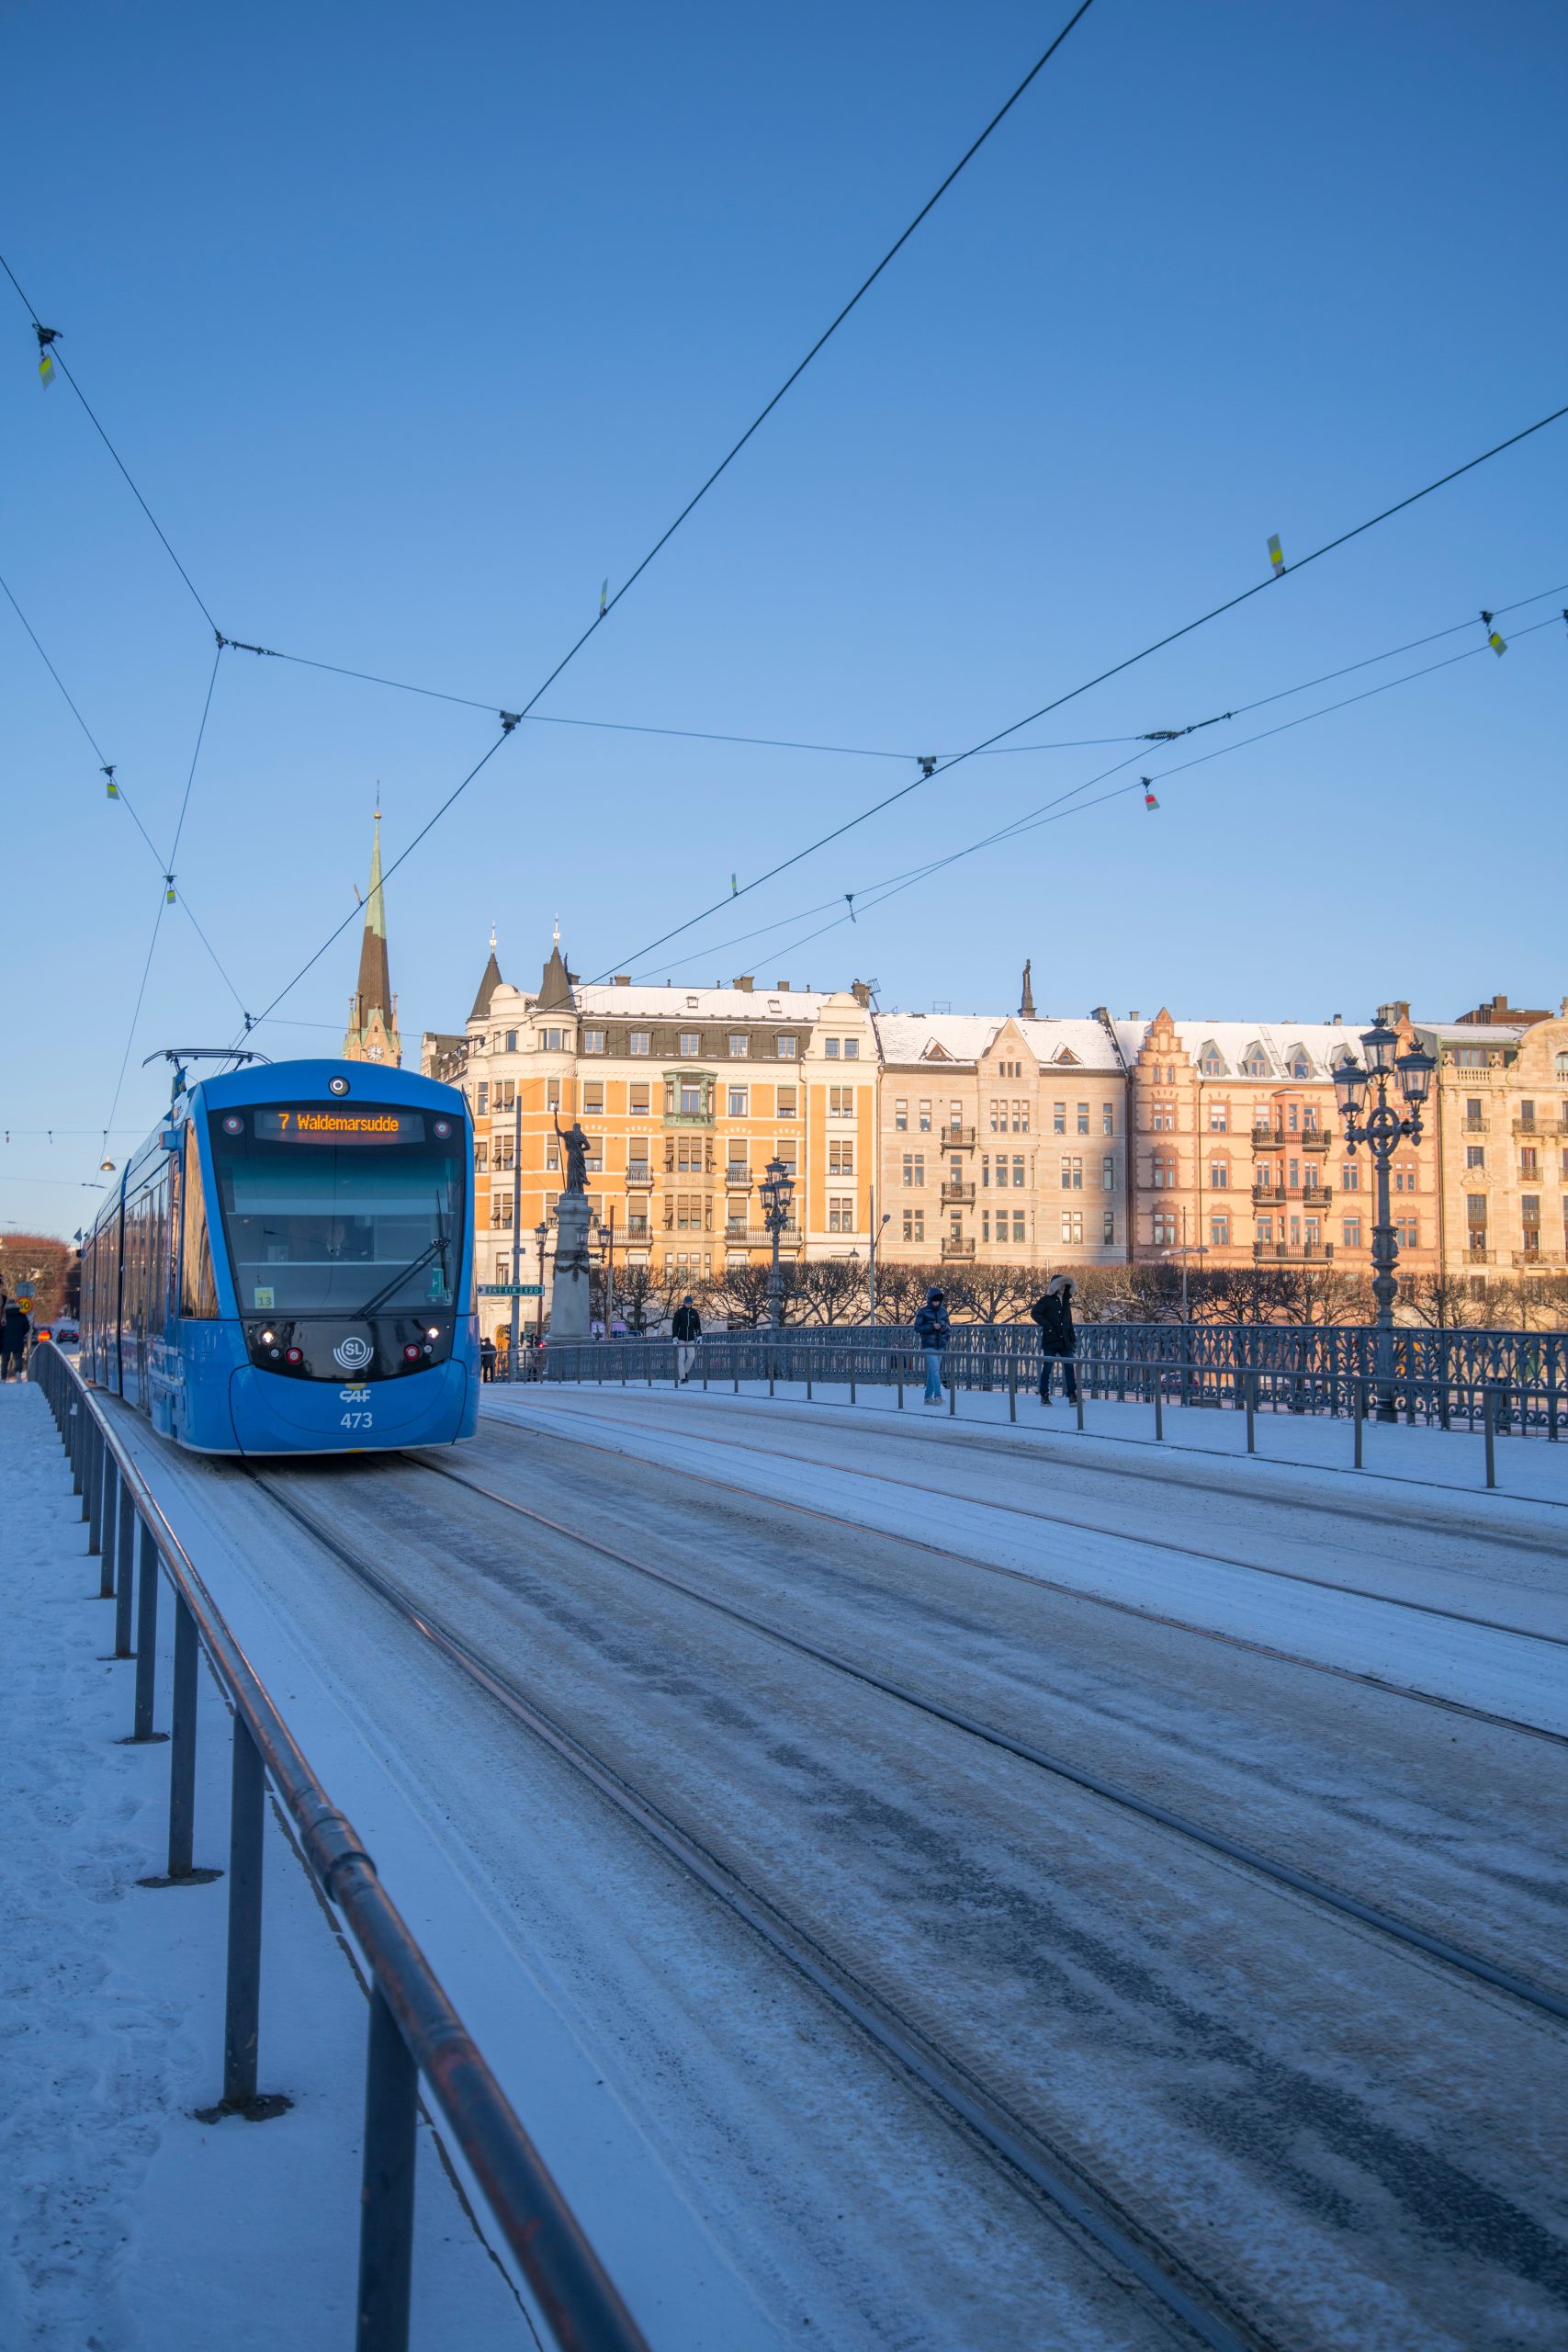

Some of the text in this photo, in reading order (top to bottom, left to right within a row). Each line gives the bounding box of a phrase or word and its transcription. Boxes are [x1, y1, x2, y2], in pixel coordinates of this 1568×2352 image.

[278, 1114, 399, 1132] 7 Waldemarsudde
[258, 1296, 272, 1306] 13
[345, 1343, 363, 1355] SL
[339, 1389, 372, 1403] CAF
[340, 1411, 373, 1429] 473
